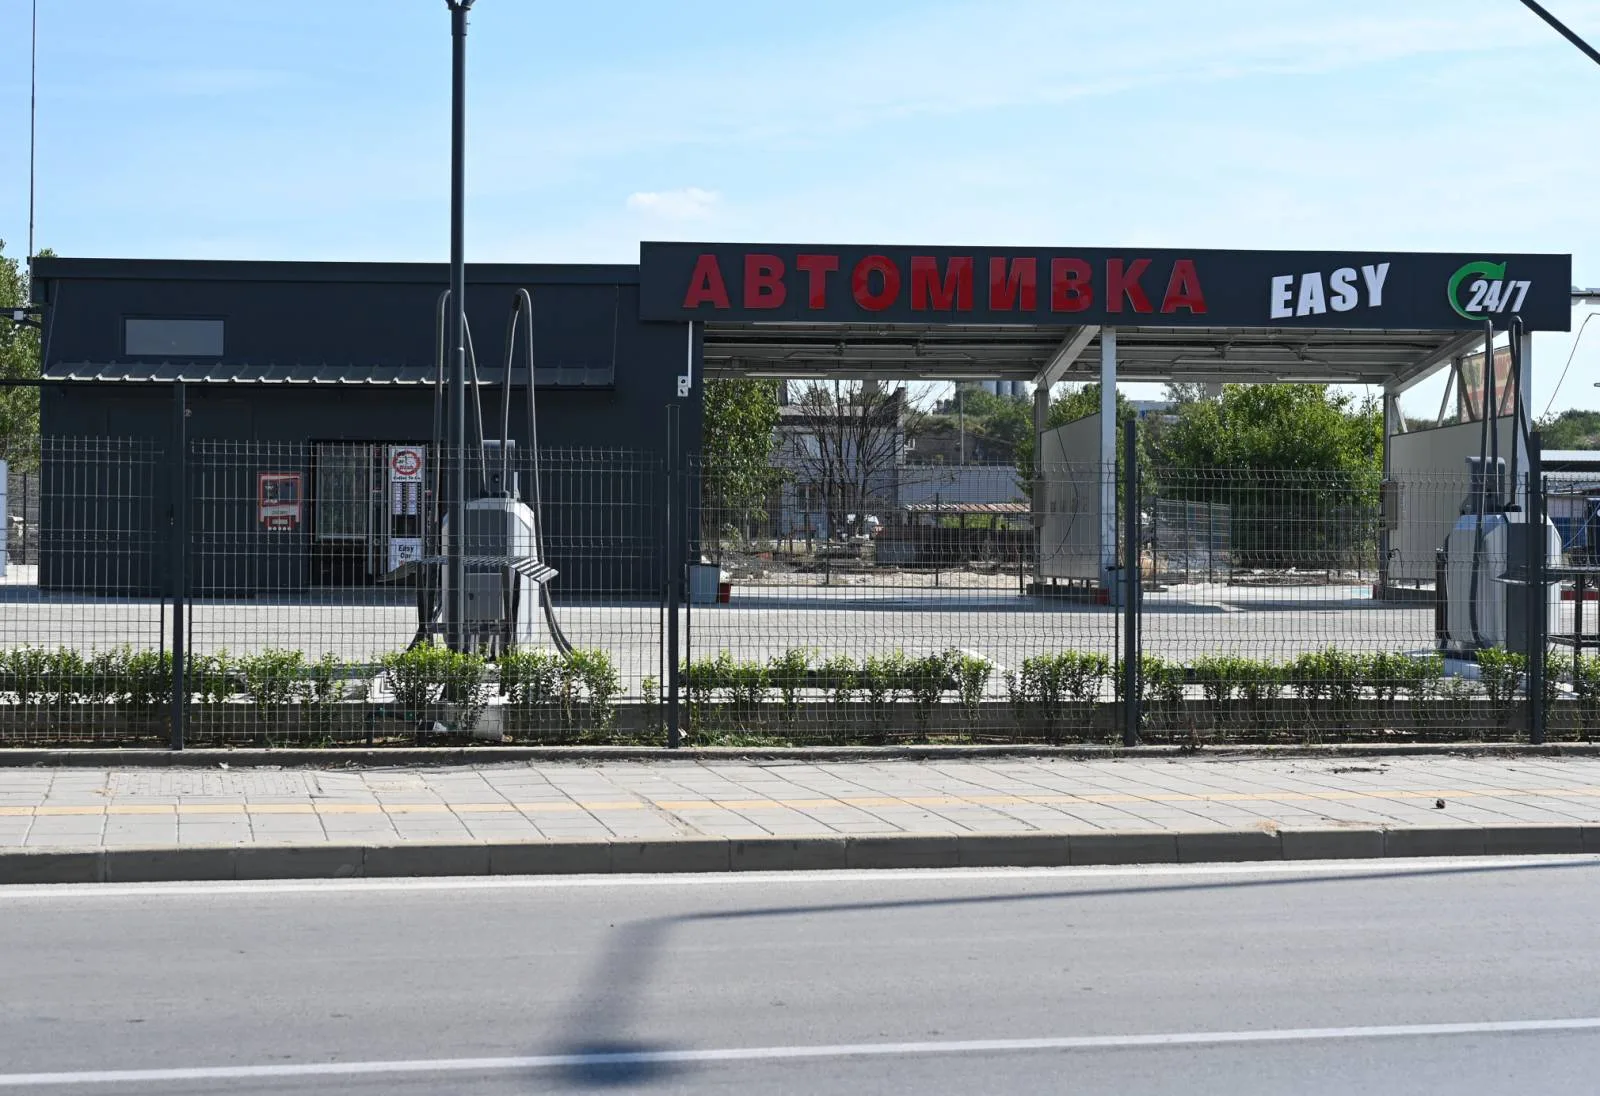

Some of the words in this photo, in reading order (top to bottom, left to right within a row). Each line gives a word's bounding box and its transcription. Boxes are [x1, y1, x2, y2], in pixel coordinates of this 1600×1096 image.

[683, 254, 1208, 314] АВТОМИВКА
[1272, 263, 1389, 318] EASY
[1466, 280, 1530, 312] 24/7
[398, 545, 414, 553] Easy
